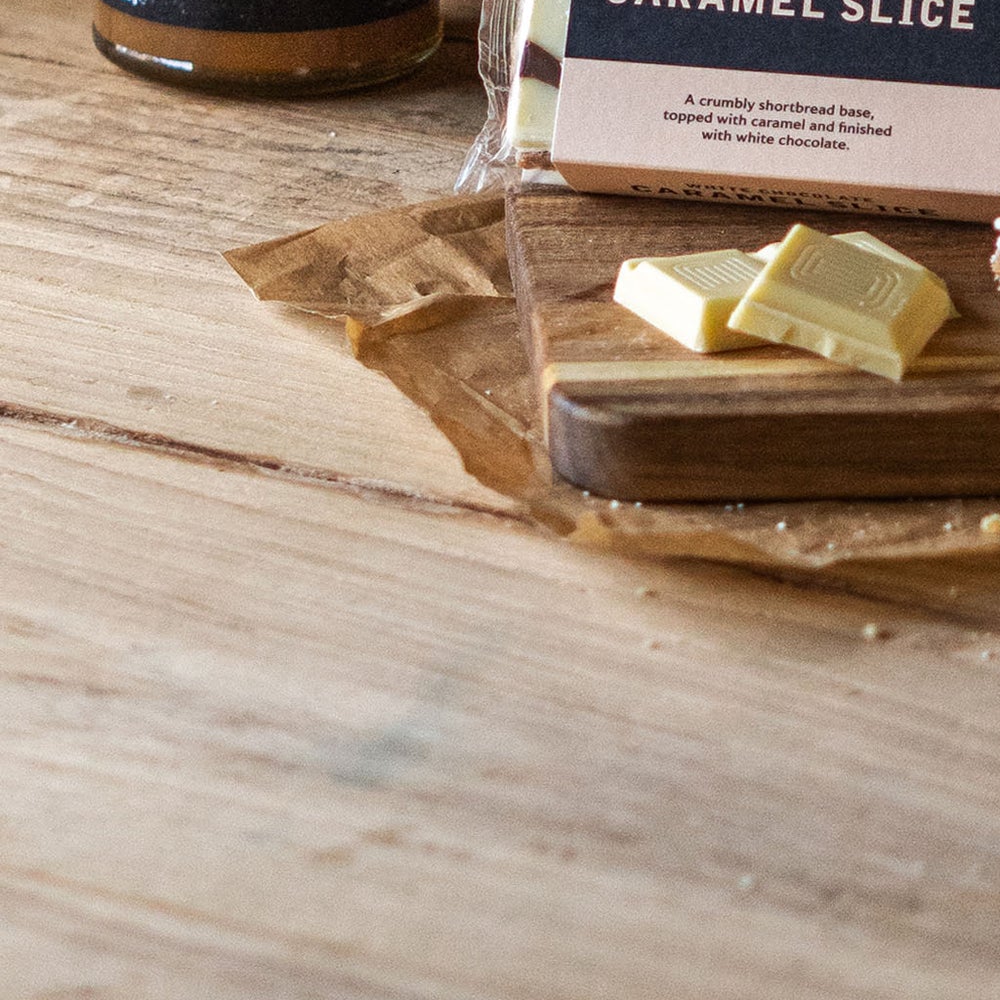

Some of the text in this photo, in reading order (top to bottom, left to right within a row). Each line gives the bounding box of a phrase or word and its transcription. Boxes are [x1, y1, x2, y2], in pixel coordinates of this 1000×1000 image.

[685, 94, 875, 121] A crumbly shortbread base,
[663, 110, 893, 137] topped with caramel and finished
[702, 128, 851, 151] with white chocolate.
[630, 184, 940, 217] CARAMEL SLICE
[685, 183, 751, 193] WHITE
